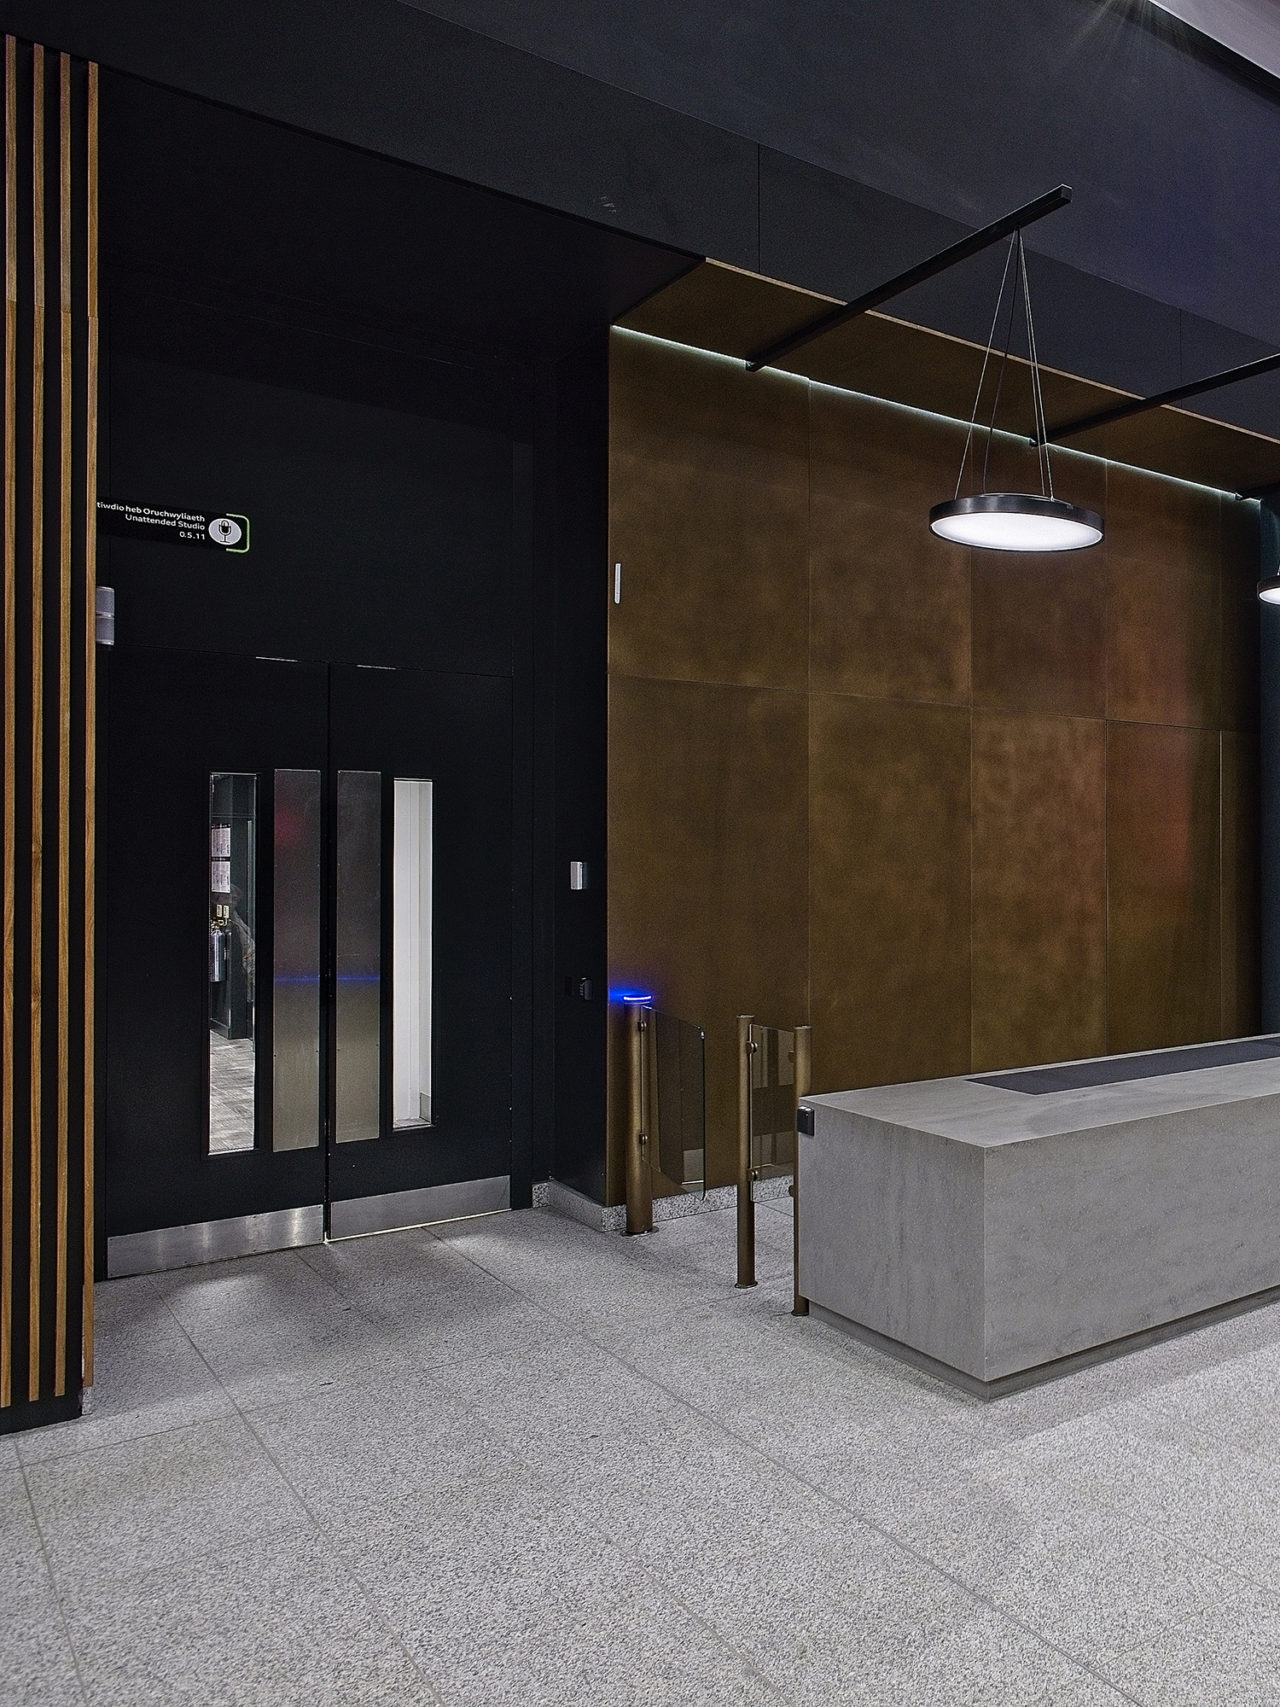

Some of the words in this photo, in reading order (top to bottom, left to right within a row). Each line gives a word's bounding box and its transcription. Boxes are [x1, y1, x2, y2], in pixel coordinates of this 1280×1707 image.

[96, 501, 124, 512] tiwdio
[125, 505, 142, 514] heb
[143, 508, 205, 522] Oruchwyliaeth
[125, 514, 176, 527] Unattended
[178, 520, 205, 531] Studio
[179, 531, 205, 541] 0.5.11
